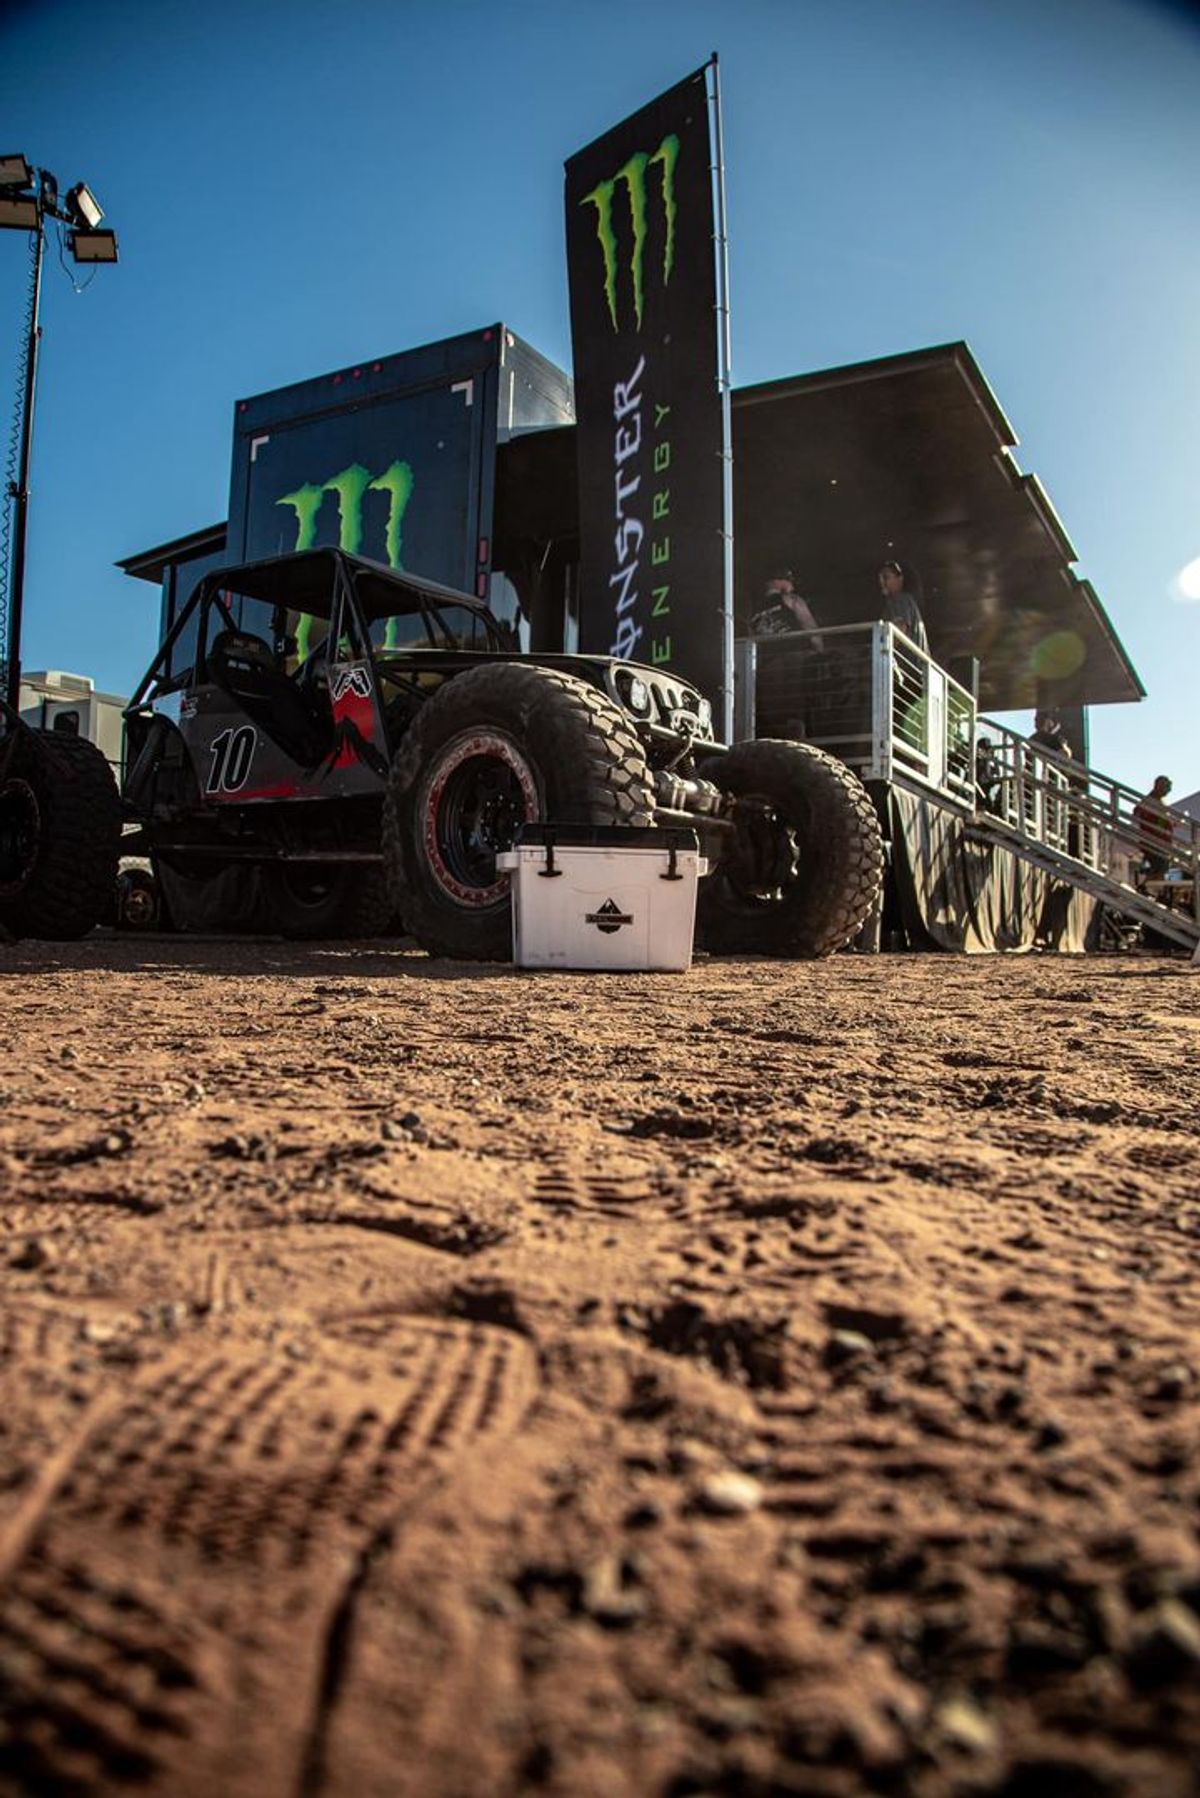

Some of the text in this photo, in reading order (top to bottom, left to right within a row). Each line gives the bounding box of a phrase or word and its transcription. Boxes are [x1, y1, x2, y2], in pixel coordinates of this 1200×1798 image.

[609, 354, 645, 660] ONSTER
[652, 403, 670, 663] ENERGY
[206, 725, 256, 793] 10
